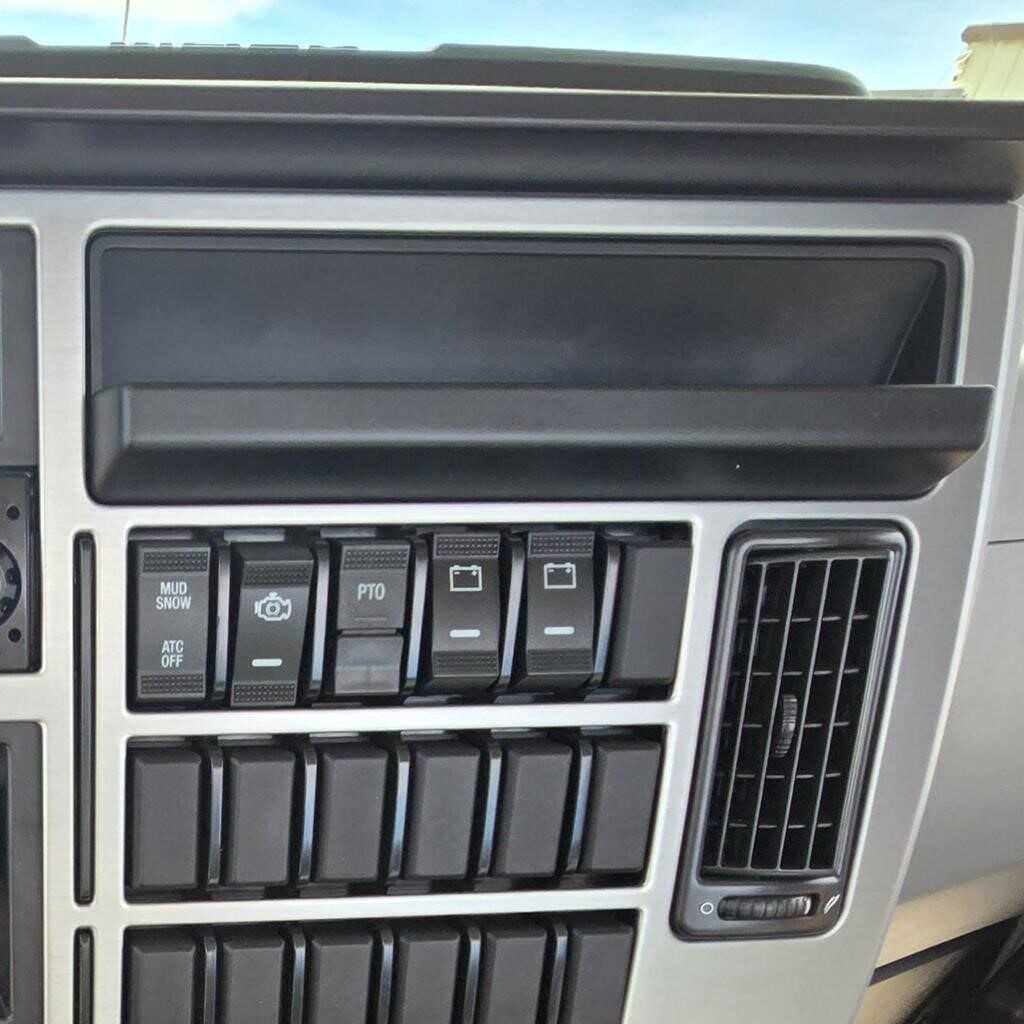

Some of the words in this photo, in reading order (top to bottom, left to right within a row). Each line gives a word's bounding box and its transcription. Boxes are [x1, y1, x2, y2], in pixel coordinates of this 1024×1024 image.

[160, 581, 187, 595] MUD
[357, 582, 386, 600] PTO
[156, 595, 192, 610] SNOW
[161, 639, 184, 654] ATC
[161, 654, 184, 668] OFF
